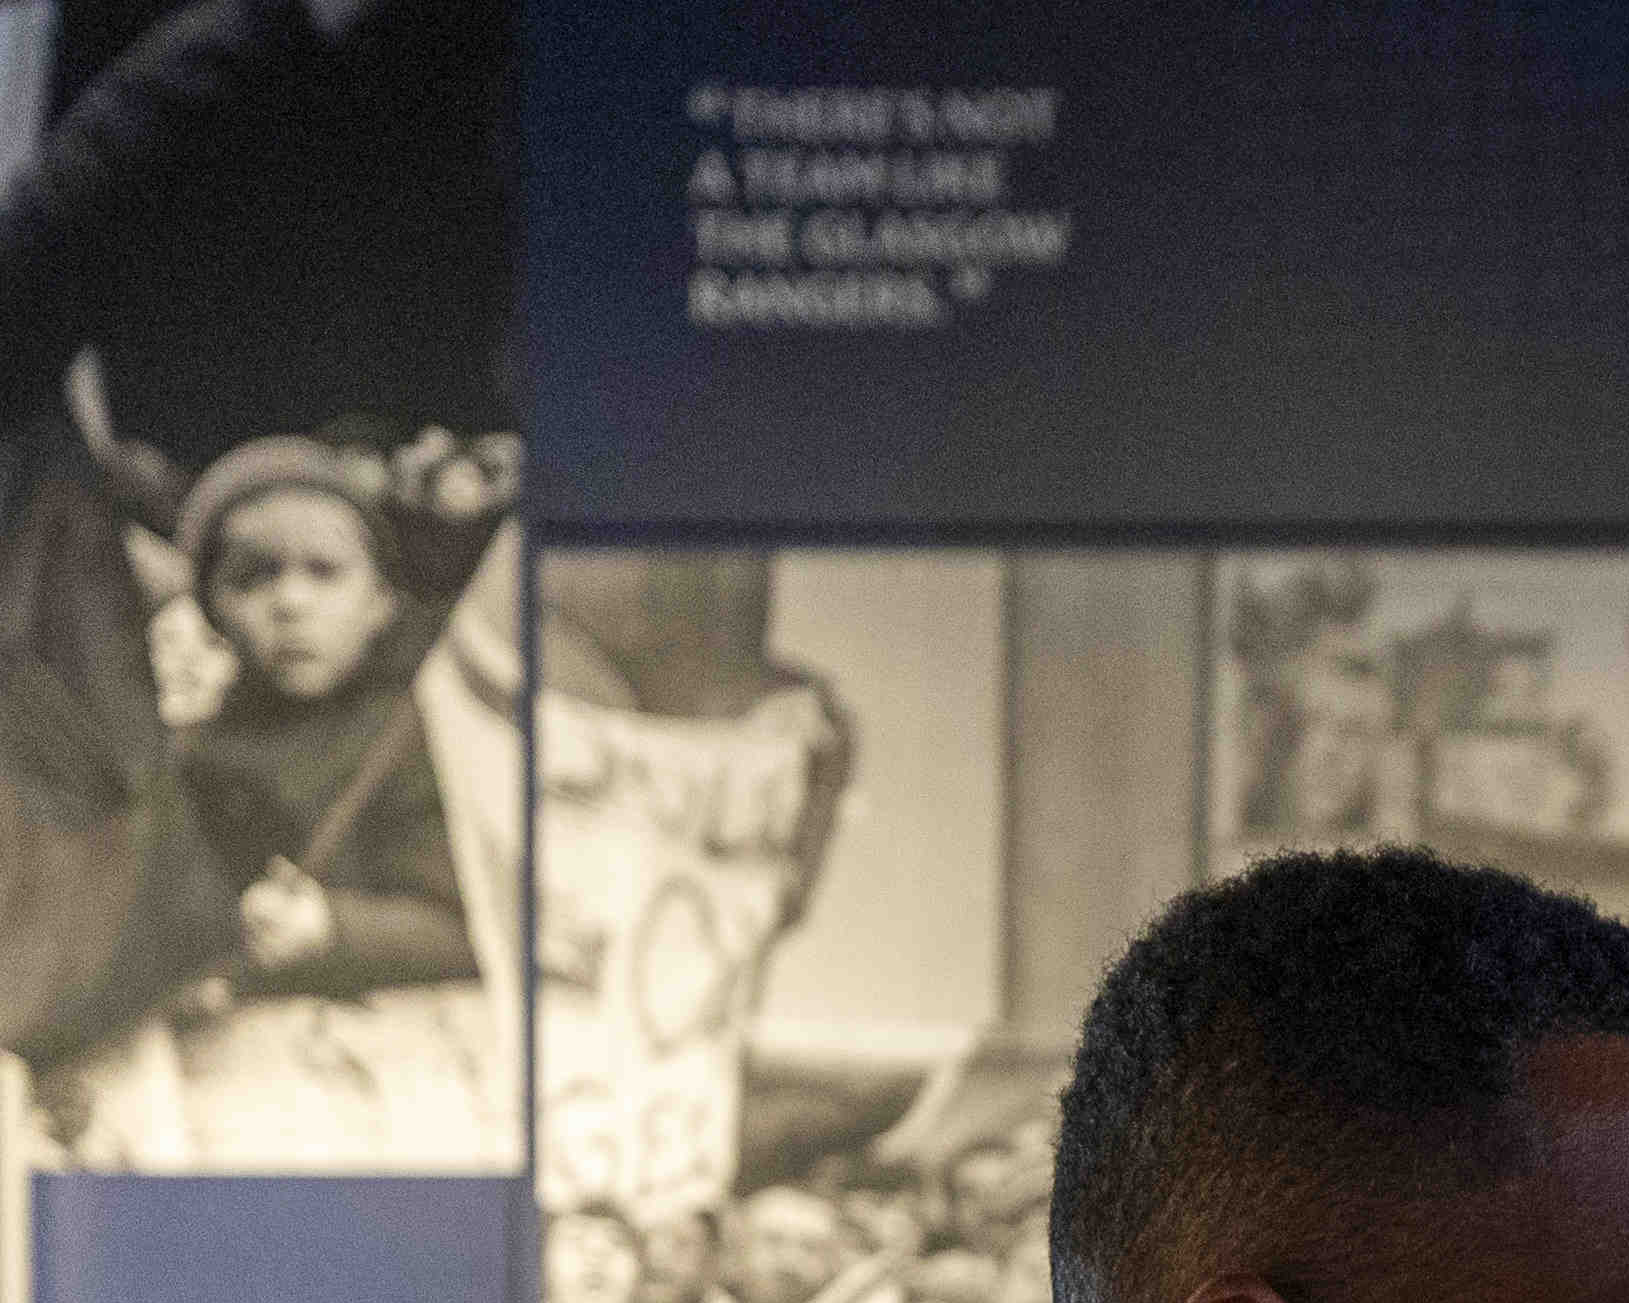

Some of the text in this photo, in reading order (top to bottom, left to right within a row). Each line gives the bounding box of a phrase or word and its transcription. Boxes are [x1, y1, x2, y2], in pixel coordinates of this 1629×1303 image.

[688, 150, 738, 203] A
[694, 208, 1074, 264] THE GLASGOW
